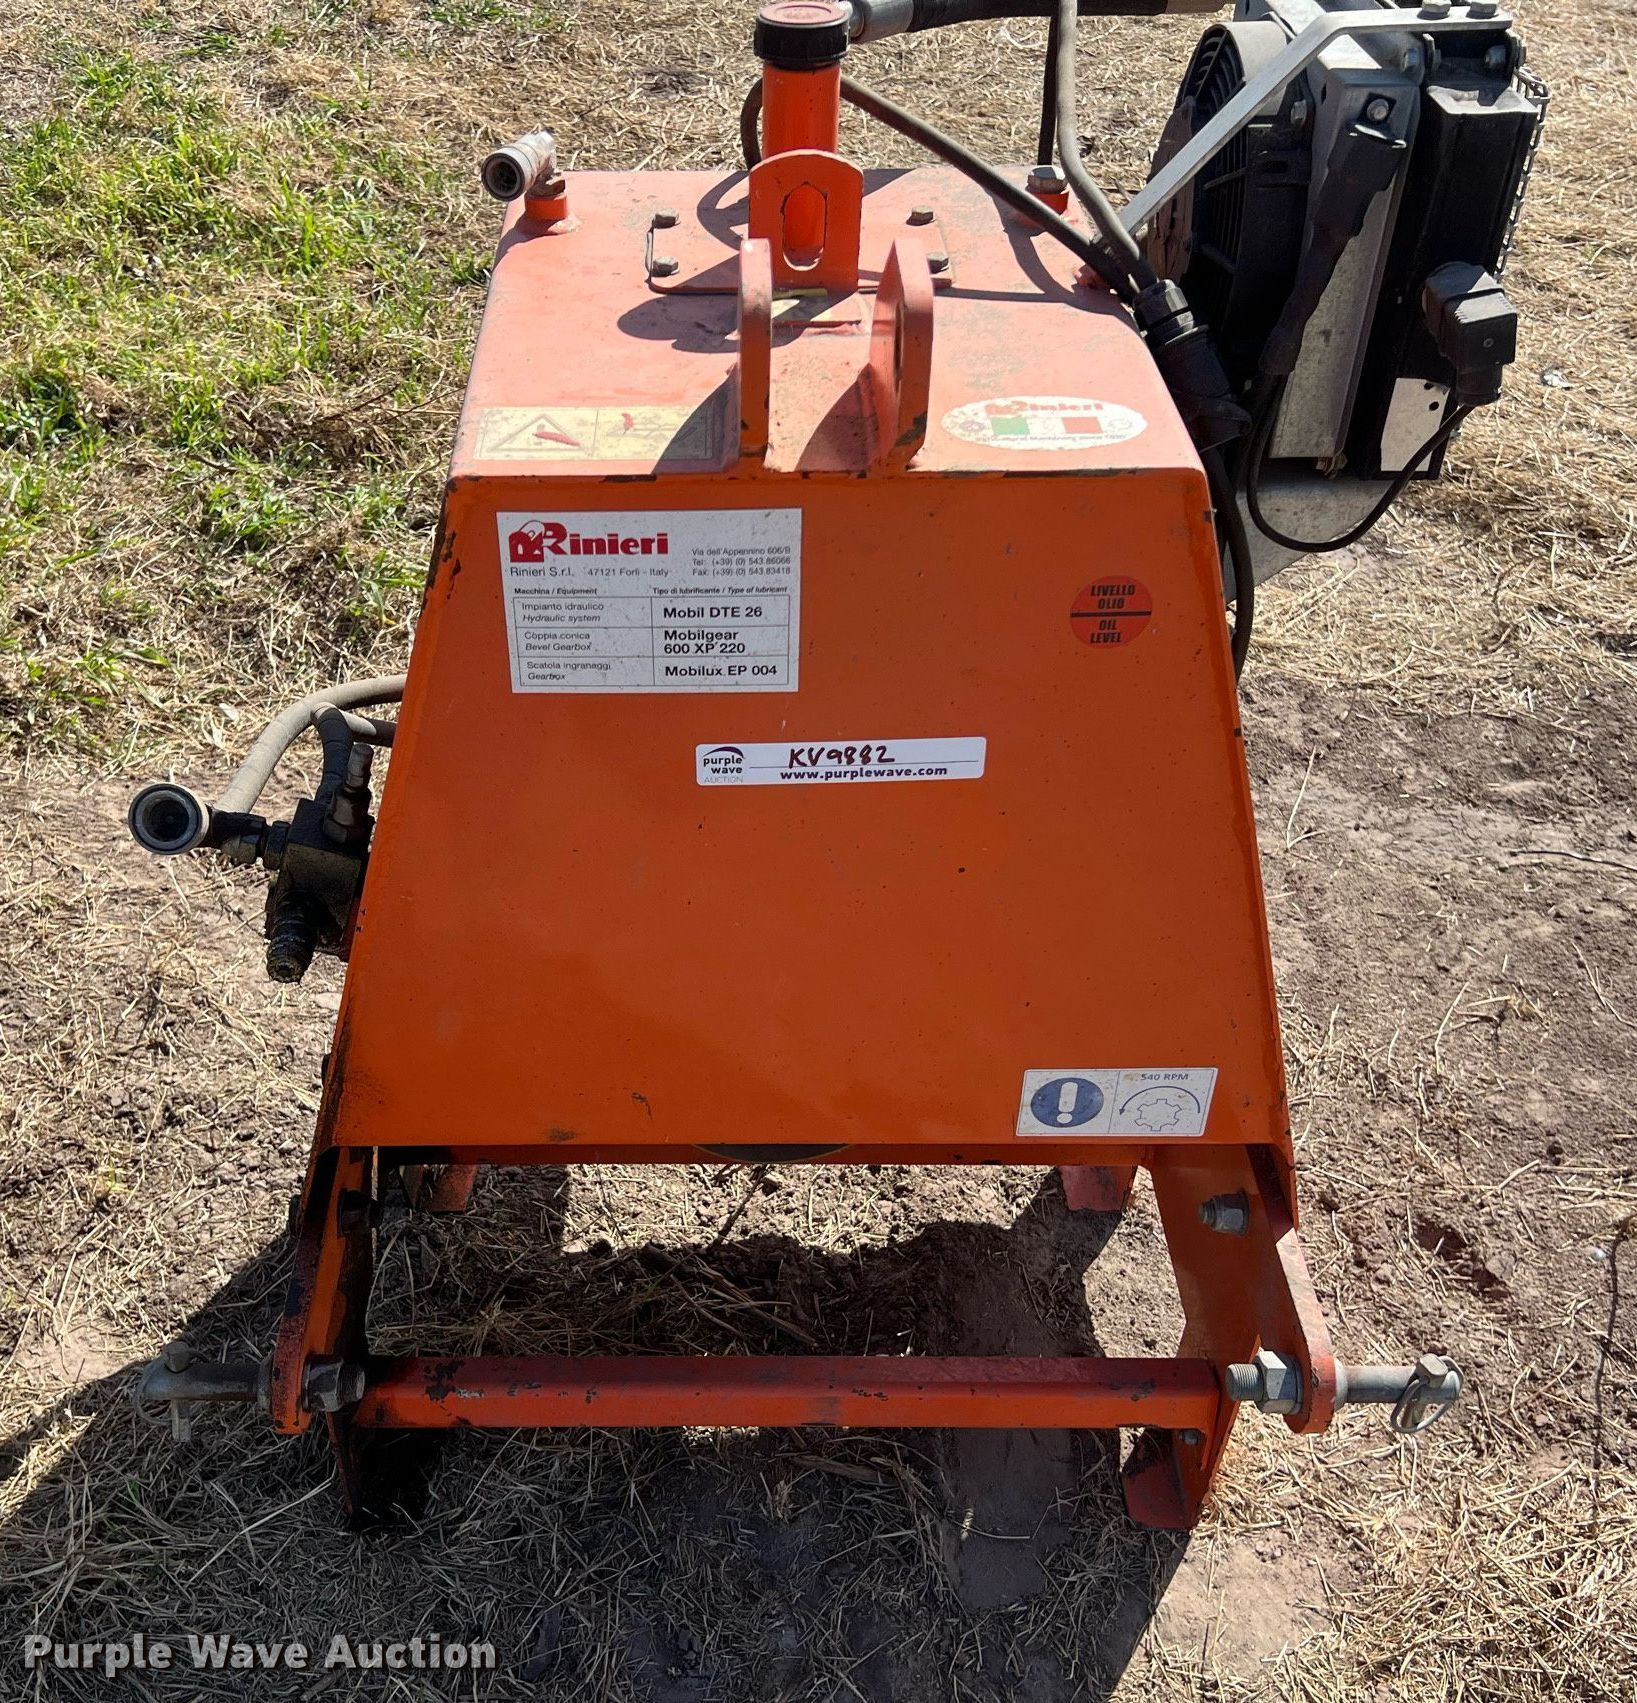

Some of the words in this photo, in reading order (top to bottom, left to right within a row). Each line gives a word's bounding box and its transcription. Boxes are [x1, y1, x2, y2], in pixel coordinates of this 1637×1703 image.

[543, 522, 669, 555] Rinieri
[692, 548, 703, 556] Via
[510, 567, 546, 577] Rinieri
[549, 567, 575, 577] S.r.l.
[588, 567, 616, 577] 47121
[649, 567, 669, 578] Italy
[514, 587, 549, 595] Macchina
[557, 587, 597, 596] Equipment
[653, 587, 669, 595] Tipo
[727, 587, 744, 595] Type
[1090, 585, 1135, 596] LIVELLO
[522, 602, 562, 612] Impianto
[565, 602, 604, 611] idraulico
[1098, 598, 1125, 609] OLIO
[664, 606, 704, 618] Mobil
[709, 606, 741, 618] DTE
[745, 606, 762, 617] 26
[523, 614, 565, 623] Hydraulic
[568, 615, 601, 623] system
[1099, 619, 1117, 631] OIL
[524, 631, 558, 640] Coppia
[560, 631, 590, 640] conica
[664, 629, 738, 643] Mobilgear
[1090, 632, 1121, 643] LEVEL
[525, 643, 551, 651] Bevel
[553, 642, 591, 651] Gearbox
[664, 643, 690, 654] 600
[694, 643, 715, 653] XP
[719, 643, 746, 653] 220
[527, 661, 561, 669] Scatola
[563, 661, 611, 671] ingranaggi
[665, 665, 722, 676] Mobilux
[728, 665, 747, 676] EP
[751, 665, 777, 676] 004
[528, 672, 566, 681] Gearbox
[703, 755, 743, 766] purple
[788, 745, 896, 768] KV9882
[711, 766, 743, 774] wave
[780, 766, 948, 780] www.purplewave.com
[704, 775, 744, 784] AUCTION
[1141, 1073, 1161, 1081] 540
[1164, 1073, 1189, 1081] RPM
